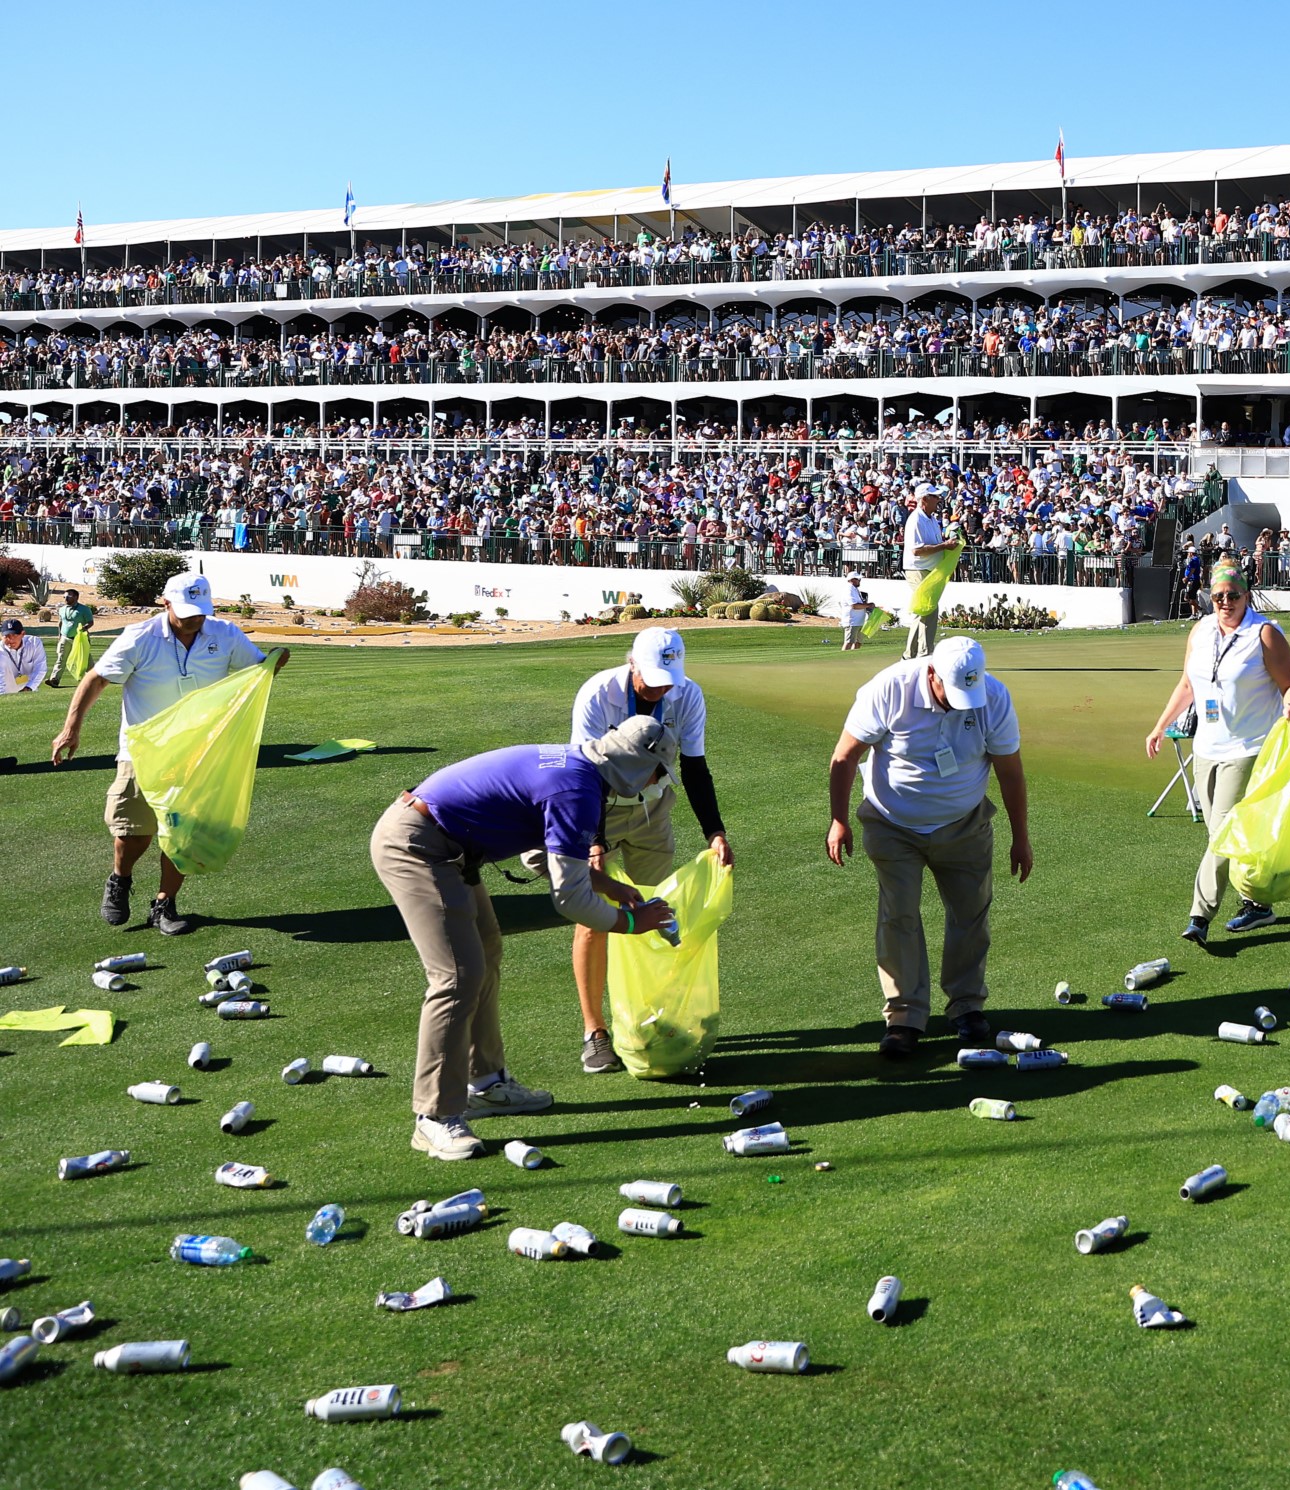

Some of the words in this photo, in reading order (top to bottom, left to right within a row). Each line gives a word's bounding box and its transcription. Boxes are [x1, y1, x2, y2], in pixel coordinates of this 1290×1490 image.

[270, 574, 299, 588] WM
[481, 587, 503, 598] FedEx
[329, 1386, 366, 1406] Lite
